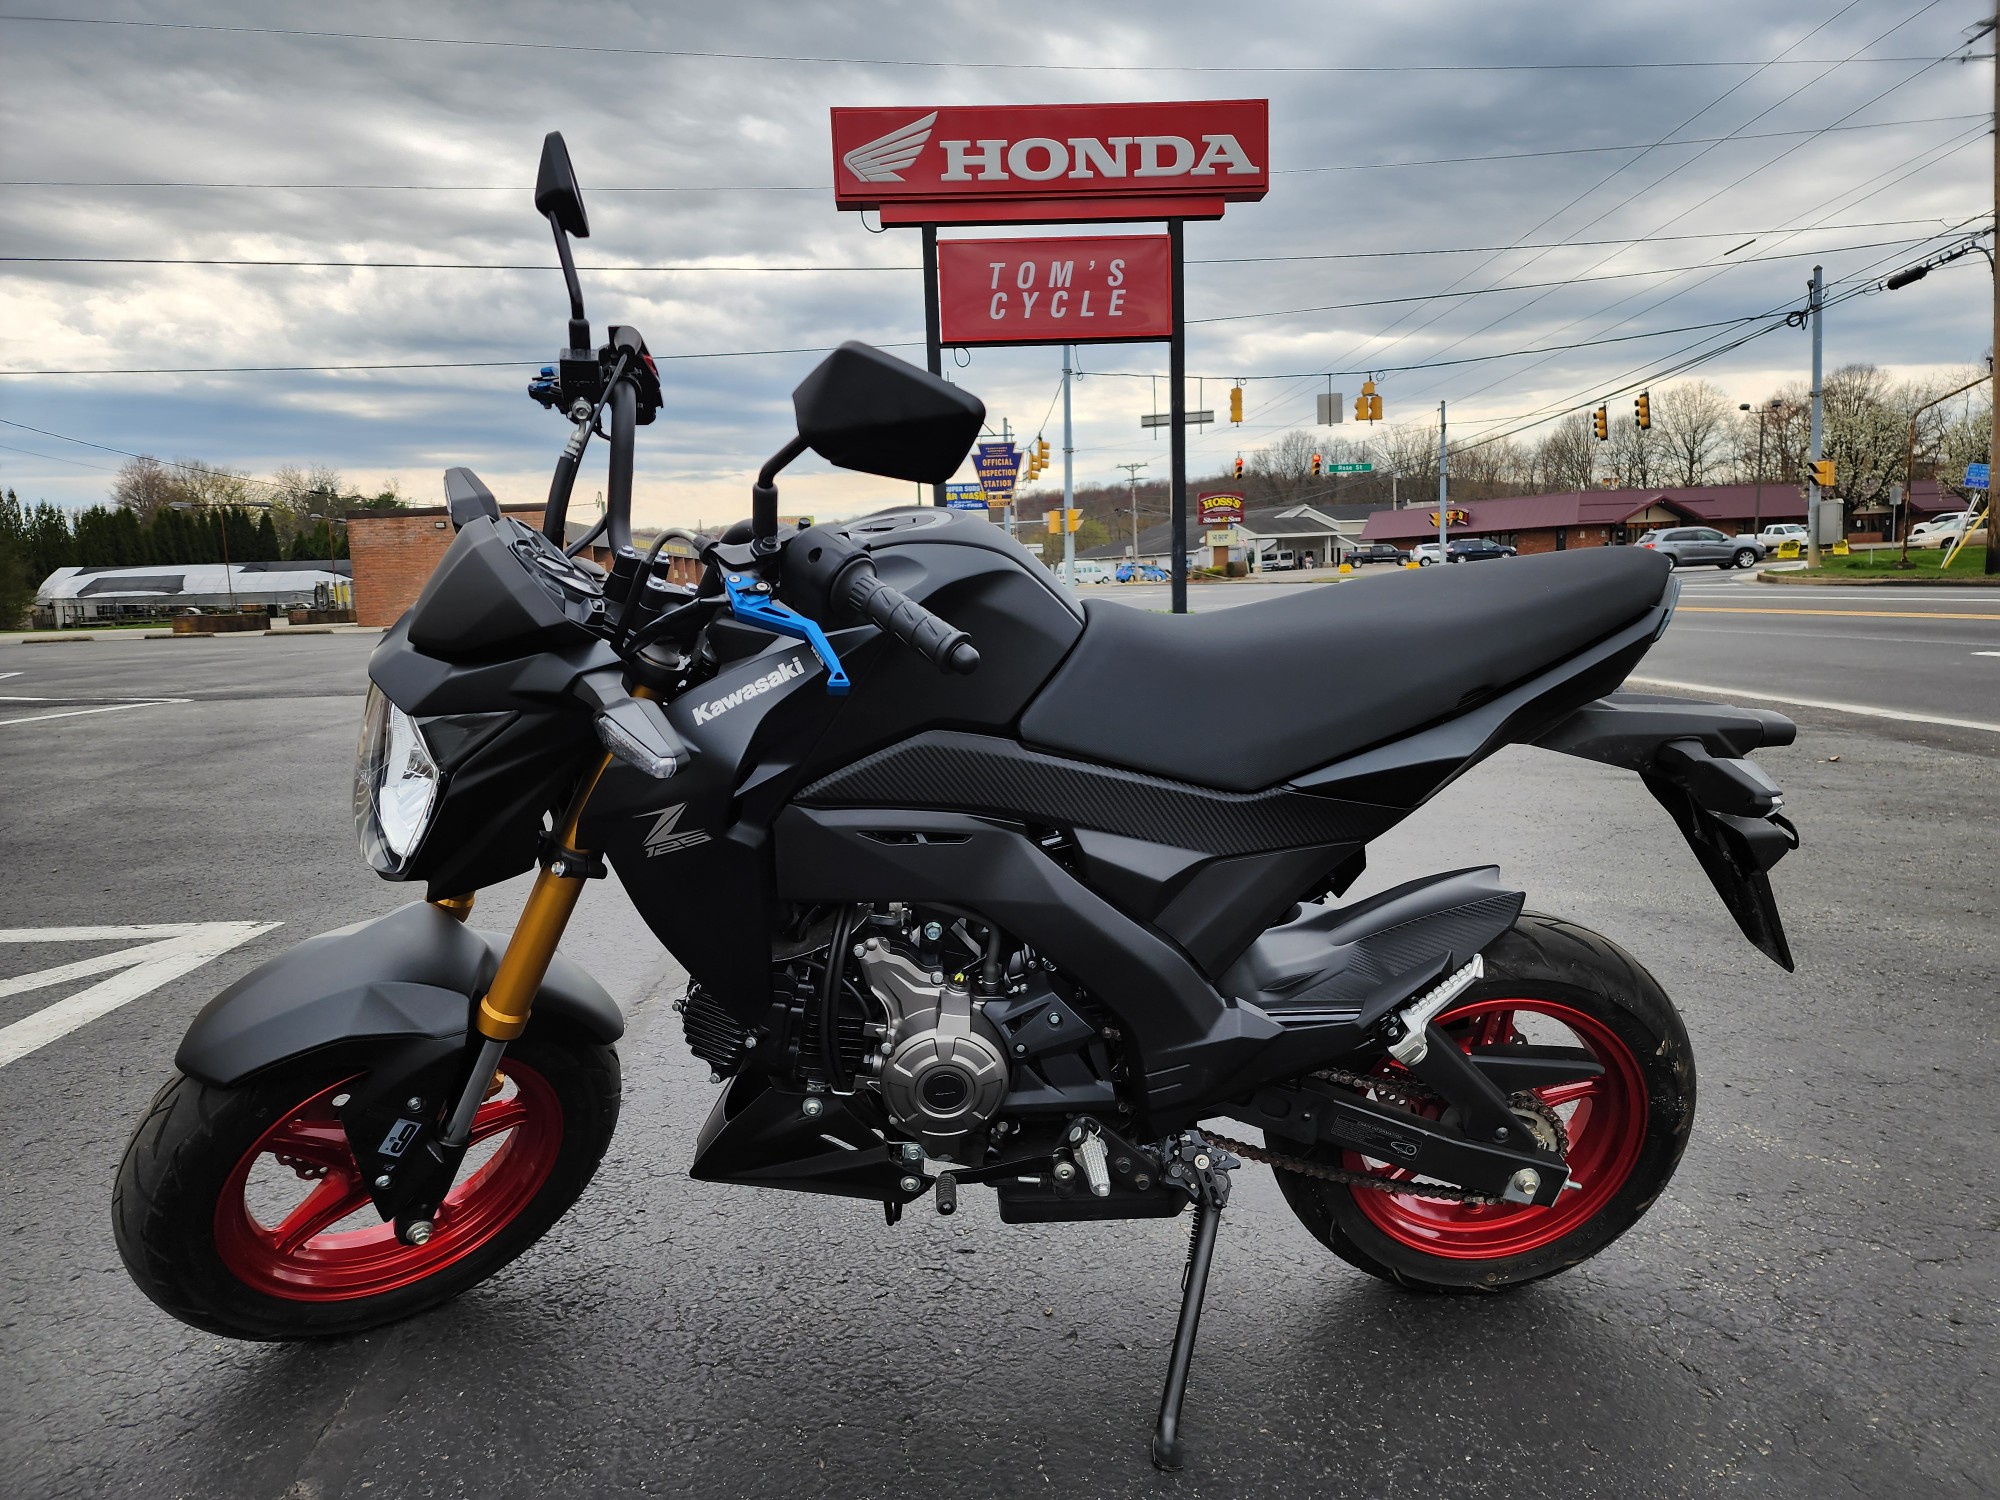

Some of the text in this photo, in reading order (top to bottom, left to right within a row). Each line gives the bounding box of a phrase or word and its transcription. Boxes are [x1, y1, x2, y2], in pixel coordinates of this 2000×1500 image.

[939, 134, 1260, 181] HONDA
[989, 258, 1126, 289] TOM'S
[989, 289, 1127, 320] CYCLE
[979, 469, 1017, 477] INSPECTION
[960, 491, 985, 501] WASH
[1203, 497, 1241, 509] HOSS'S
[692, 656, 805, 726] Kawasaki
[632, 802, 706, 847] Z
[645, 832, 713, 858] 125
